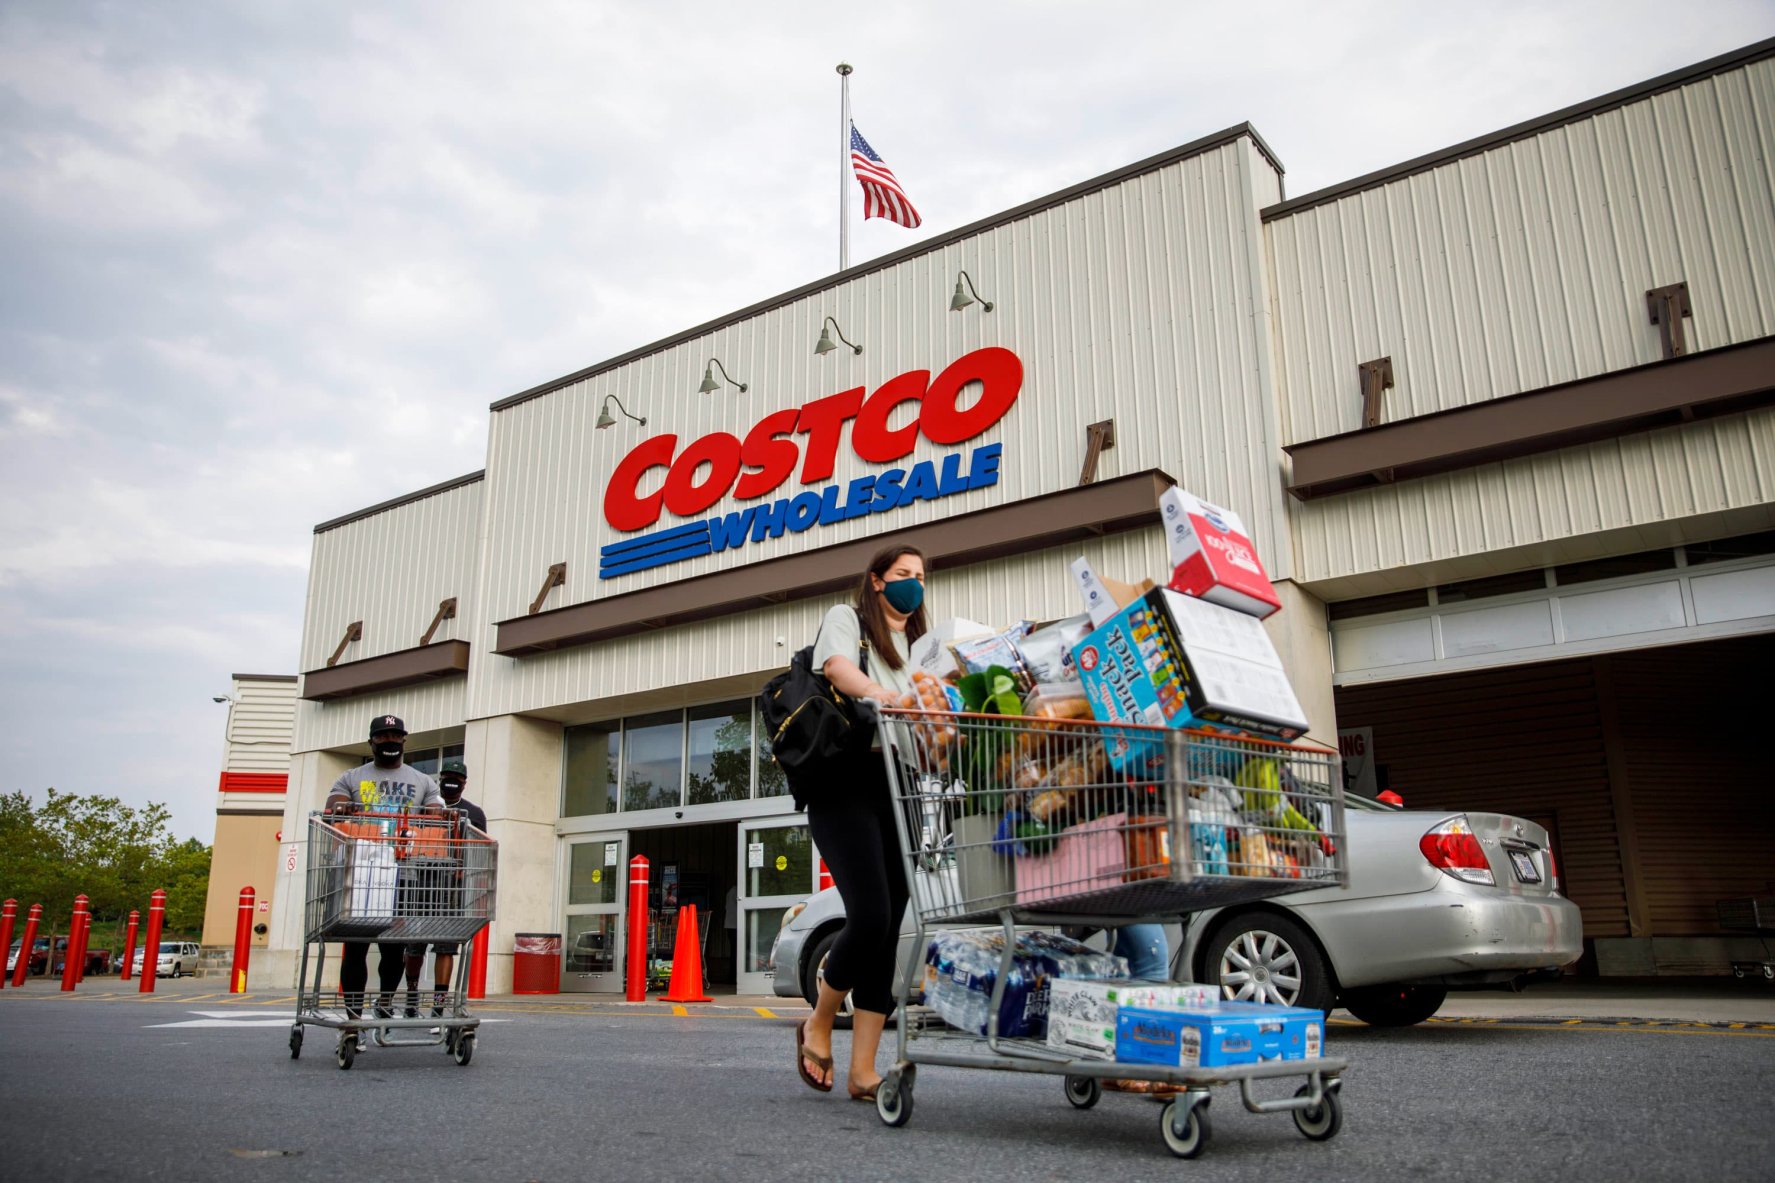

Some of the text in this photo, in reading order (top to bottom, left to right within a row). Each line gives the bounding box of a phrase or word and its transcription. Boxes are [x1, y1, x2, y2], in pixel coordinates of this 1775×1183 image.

[604, 346, 1023, 532] COSTCO
[708, 442, 1002, 552] WHOLESALE
[1107, 626, 1144, 683] Pack
[1101, 657, 1147, 725] Snack
[1338, 734, 1365, 757] ING
[359, 780, 416, 798] MAKE
[1080, 990, 1098, 1007] CLAW
